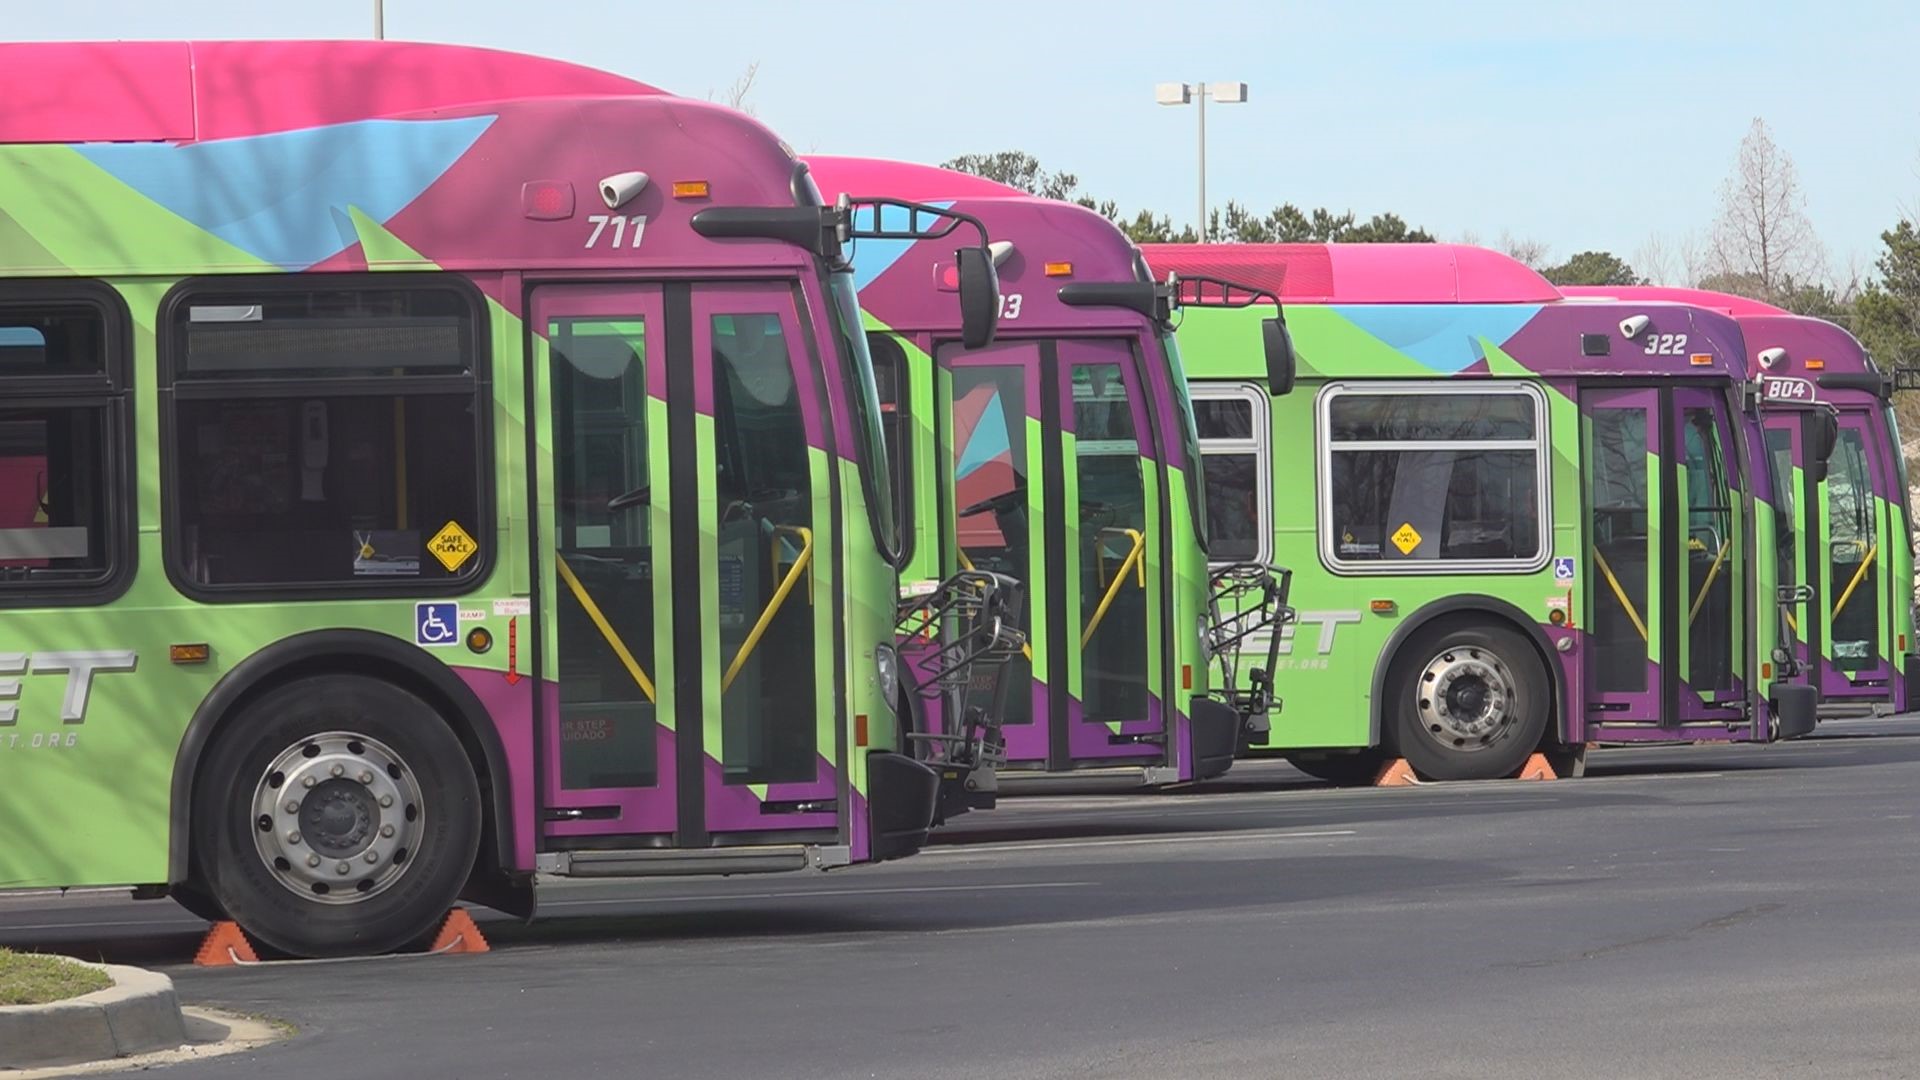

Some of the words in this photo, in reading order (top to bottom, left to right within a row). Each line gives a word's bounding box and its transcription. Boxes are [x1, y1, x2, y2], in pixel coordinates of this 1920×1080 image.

[584, 215, 648, 248] 711
[1644, 334, 1688, 355] 322
[1768, 381, 1805, 398] 804
[441, 534, 462, 544] SAFE
[0, 650, 139, 727] T
[576, 719, 607, 730] STEP
[0, 732, 78, 749] T.ORG
[561, 730, 607, 741] UIDADO
